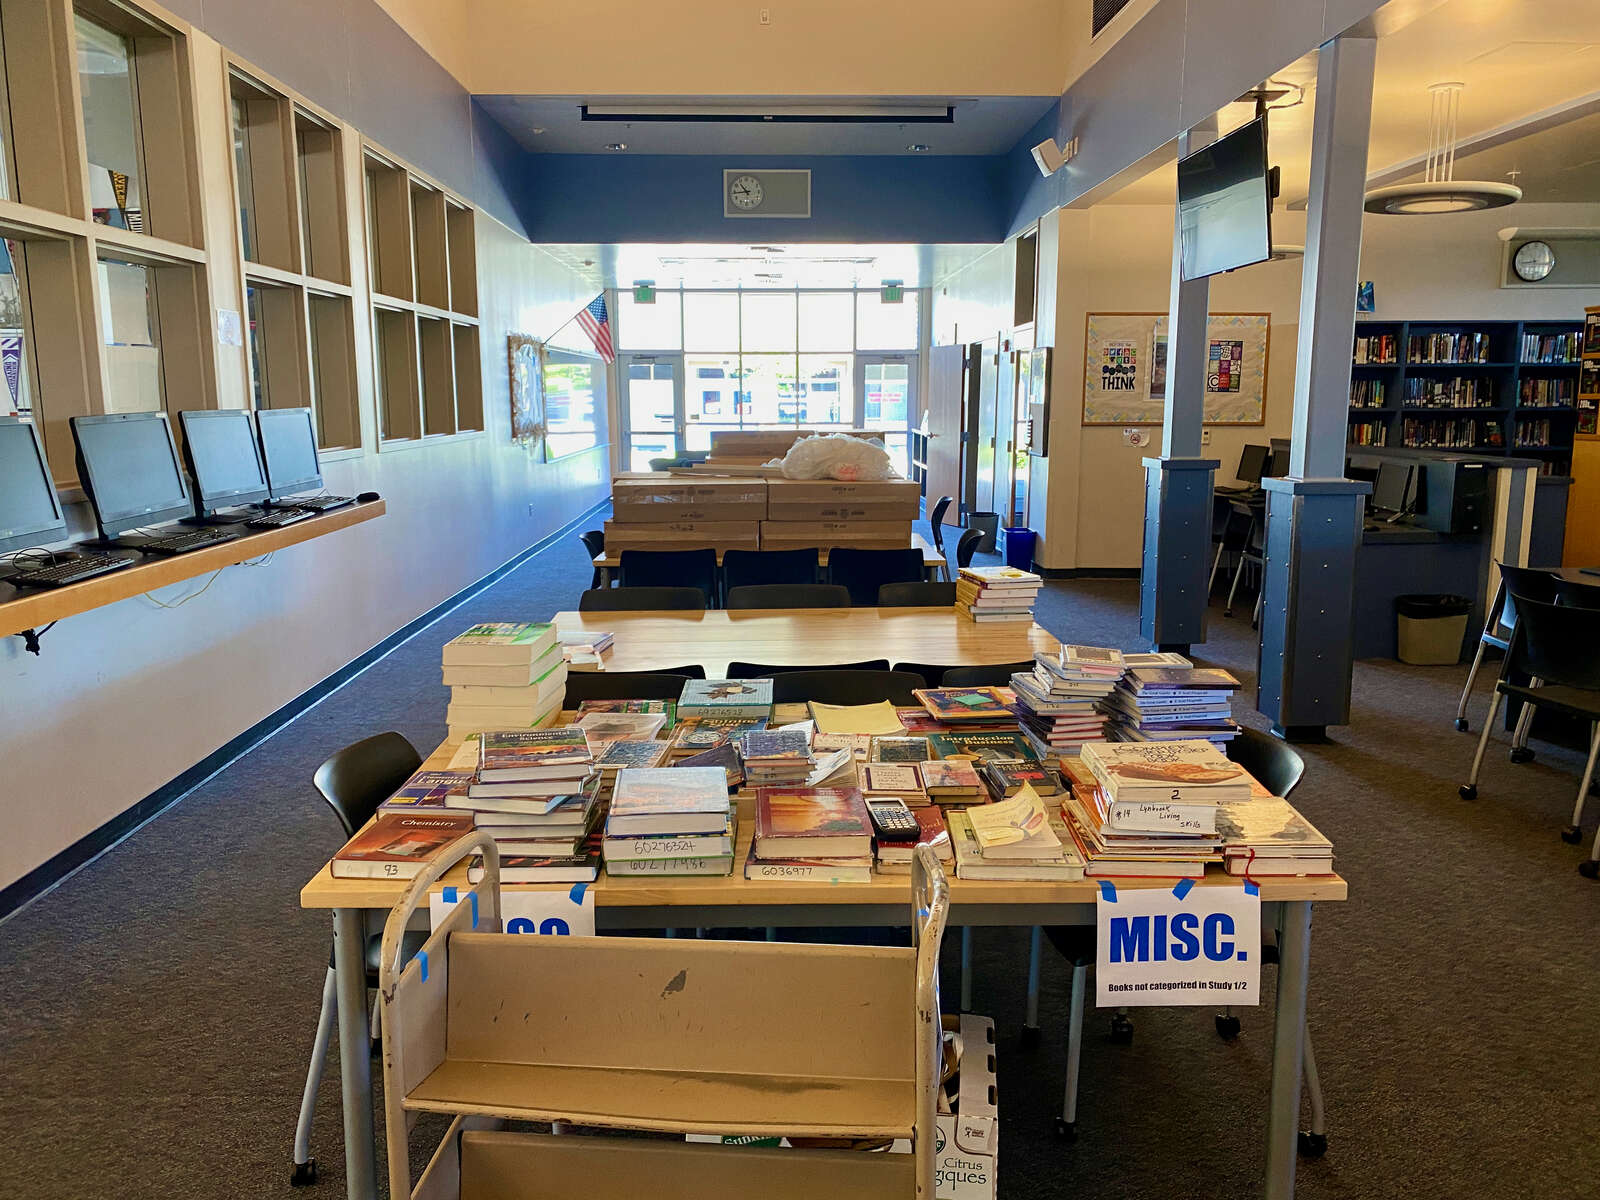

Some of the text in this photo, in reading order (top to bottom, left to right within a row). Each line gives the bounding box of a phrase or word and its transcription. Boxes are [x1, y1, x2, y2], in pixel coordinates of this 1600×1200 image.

[1101, 376, 1136, 390] THINK
[1171, 790, 1181, 800] 2
[1159, 812, 1180, 820] Living
[401, 819, 457, 827] Chemistry
[1109, 913, 1248, 963] MISC.
[1108, 981, 1248, 992] Books not categorized in Study 1/2
[944, 1157, 983, 1170] Citrus
